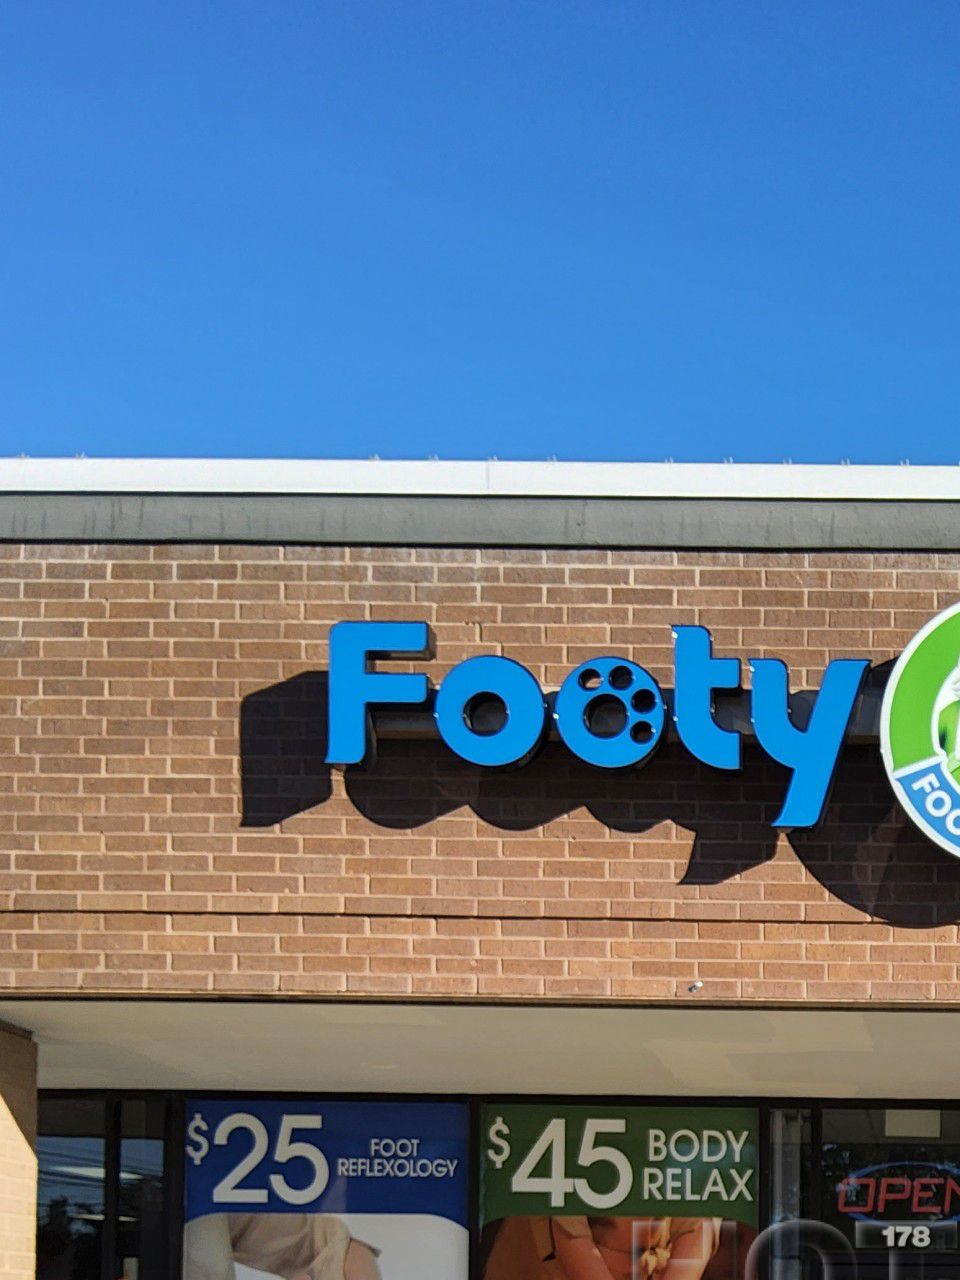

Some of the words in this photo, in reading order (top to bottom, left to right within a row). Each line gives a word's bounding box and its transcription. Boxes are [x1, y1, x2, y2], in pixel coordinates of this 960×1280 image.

[324, 620, 872, 828] Footy
[186, 1112, 330, 1205] $25
[370, 1138, 421, 1157] FOOT
[487, 1116, 634, 1209] $45
[648, 1128, 750, 1163] BODY
[337, 1158, 458, 1178] REFLEXOLOGY
[643, 1167, 754, 1201] RELAX
[882, 1225, 931, 1248] 178
